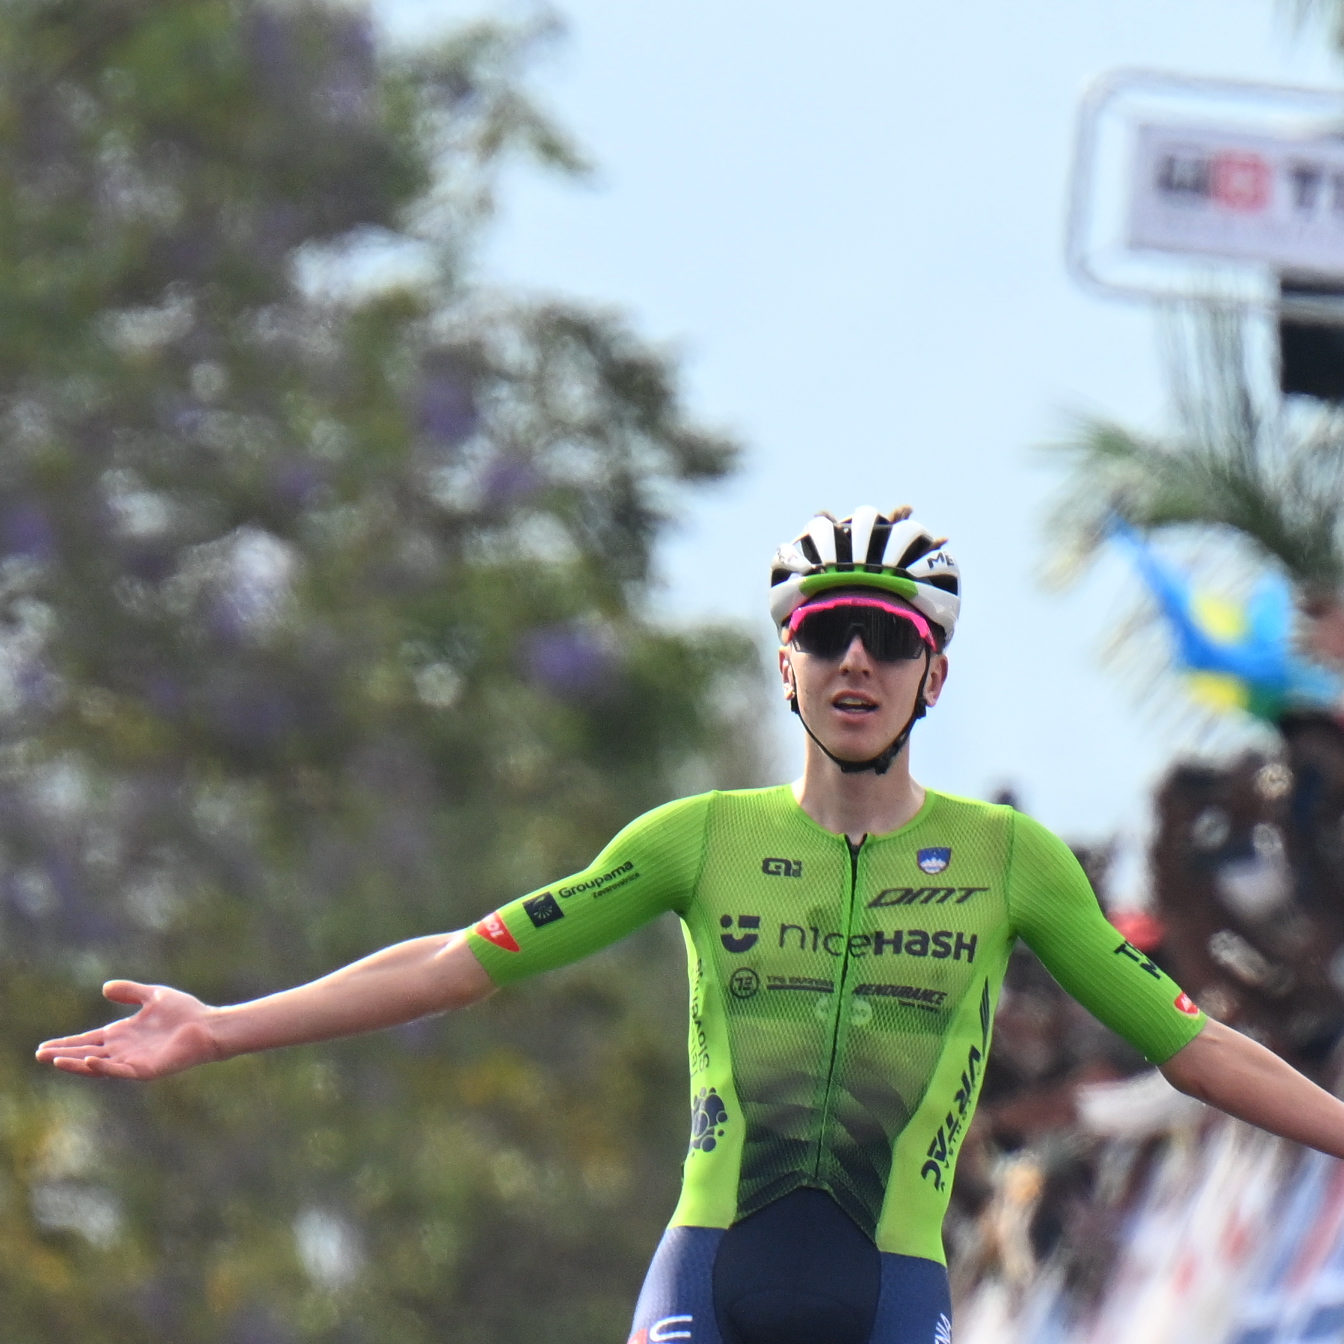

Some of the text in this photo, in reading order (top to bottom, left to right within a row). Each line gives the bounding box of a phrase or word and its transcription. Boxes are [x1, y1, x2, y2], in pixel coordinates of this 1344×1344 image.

[927, 551, 955, 570] ME
[558, 860, 634, 898] Groupama
[867, 887, 991, 909] DMT
